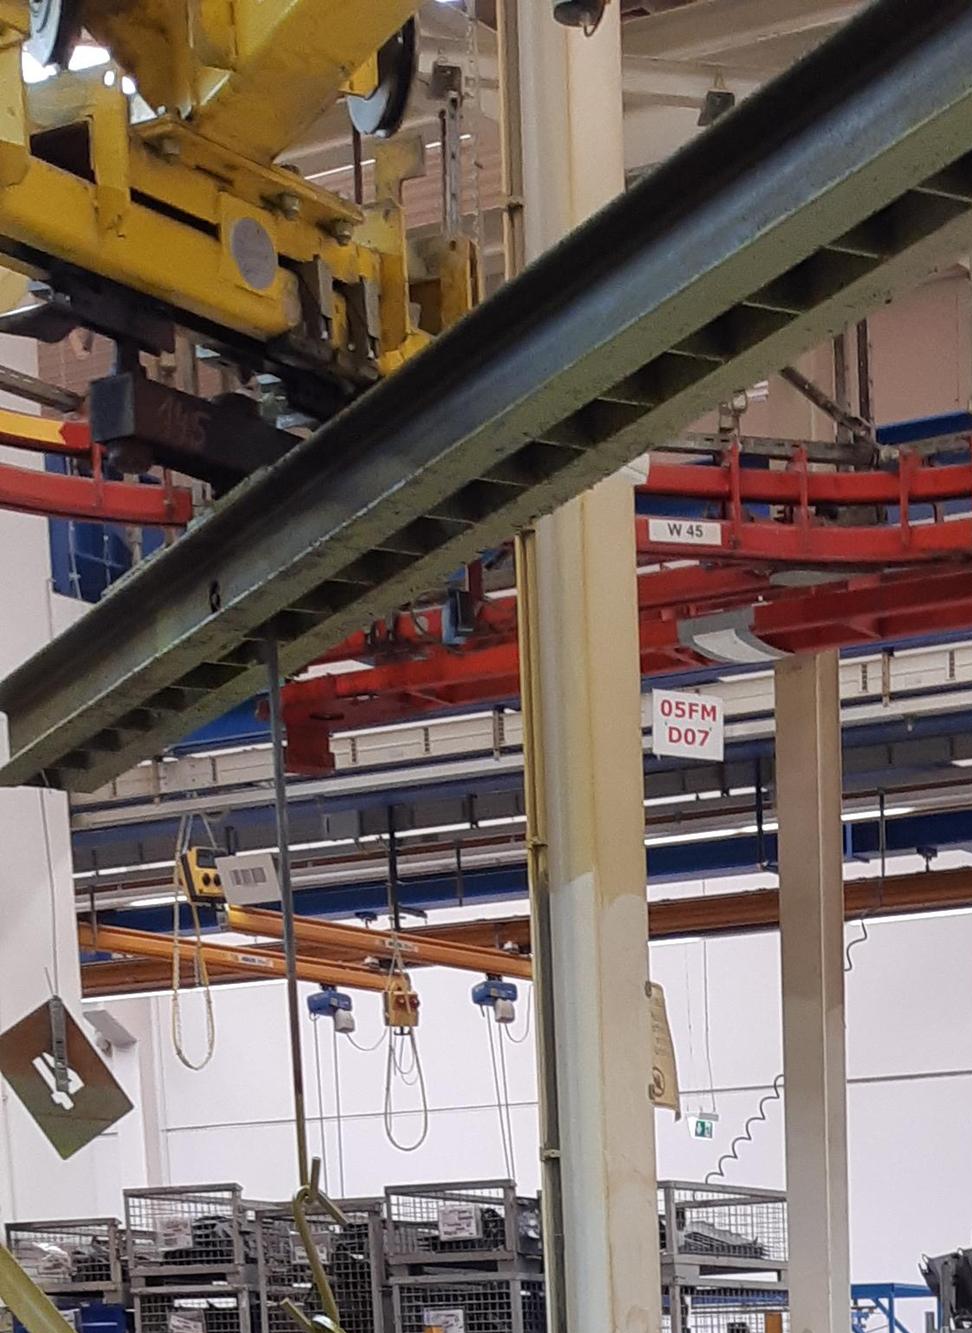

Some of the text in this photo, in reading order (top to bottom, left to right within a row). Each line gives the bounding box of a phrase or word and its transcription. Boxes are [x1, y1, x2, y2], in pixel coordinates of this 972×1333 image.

[667, 522, 703, 538] W 45
[660, 699, 717, 722] 05FM
[668, 726, 710, 747] D07
